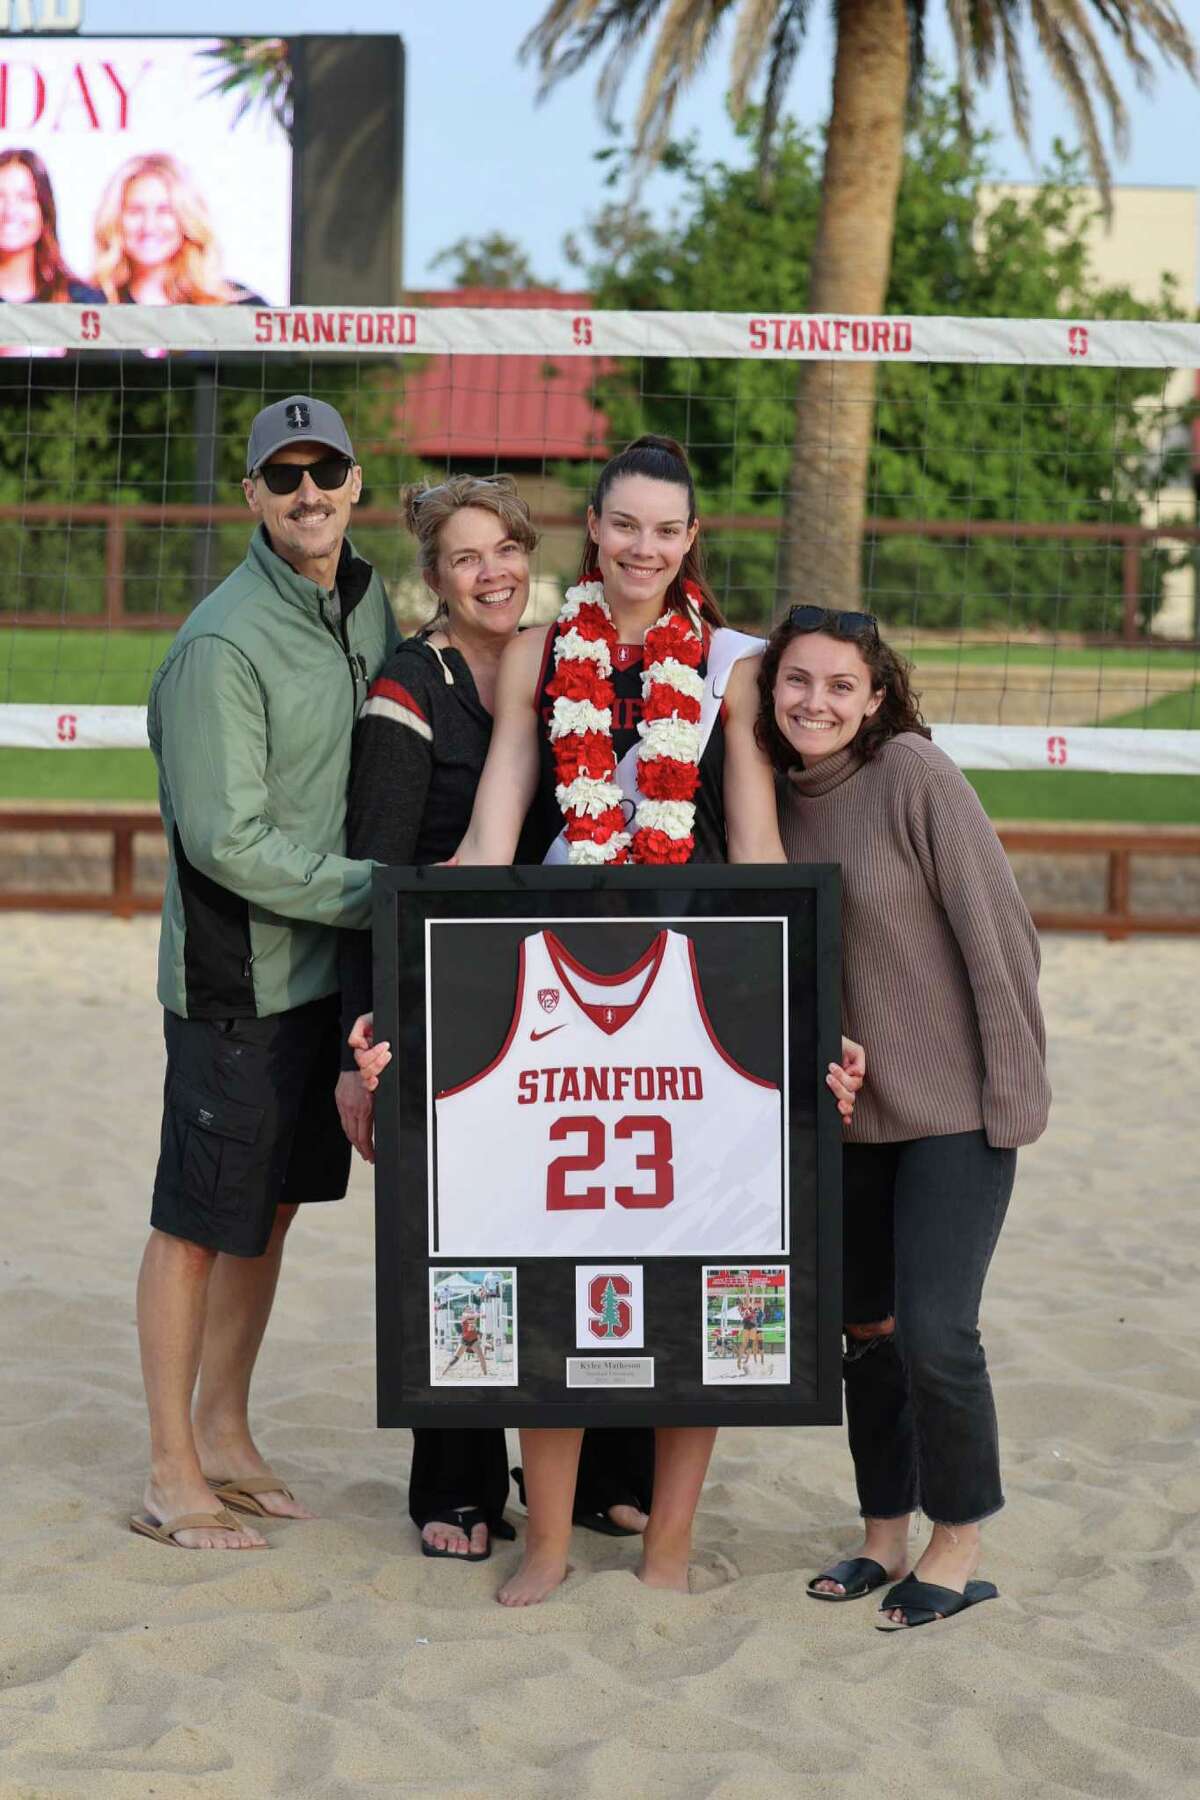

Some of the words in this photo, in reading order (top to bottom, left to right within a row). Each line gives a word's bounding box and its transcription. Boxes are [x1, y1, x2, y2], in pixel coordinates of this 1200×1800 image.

[0, 62, 152, 130] DAY
[255, 311, 416, 345] STANFORD
[749, 319, 912, 353] STANFORD
[517, 1066, 703, 1105] STANFORD
[546, 1115, 674, 1210] 23
